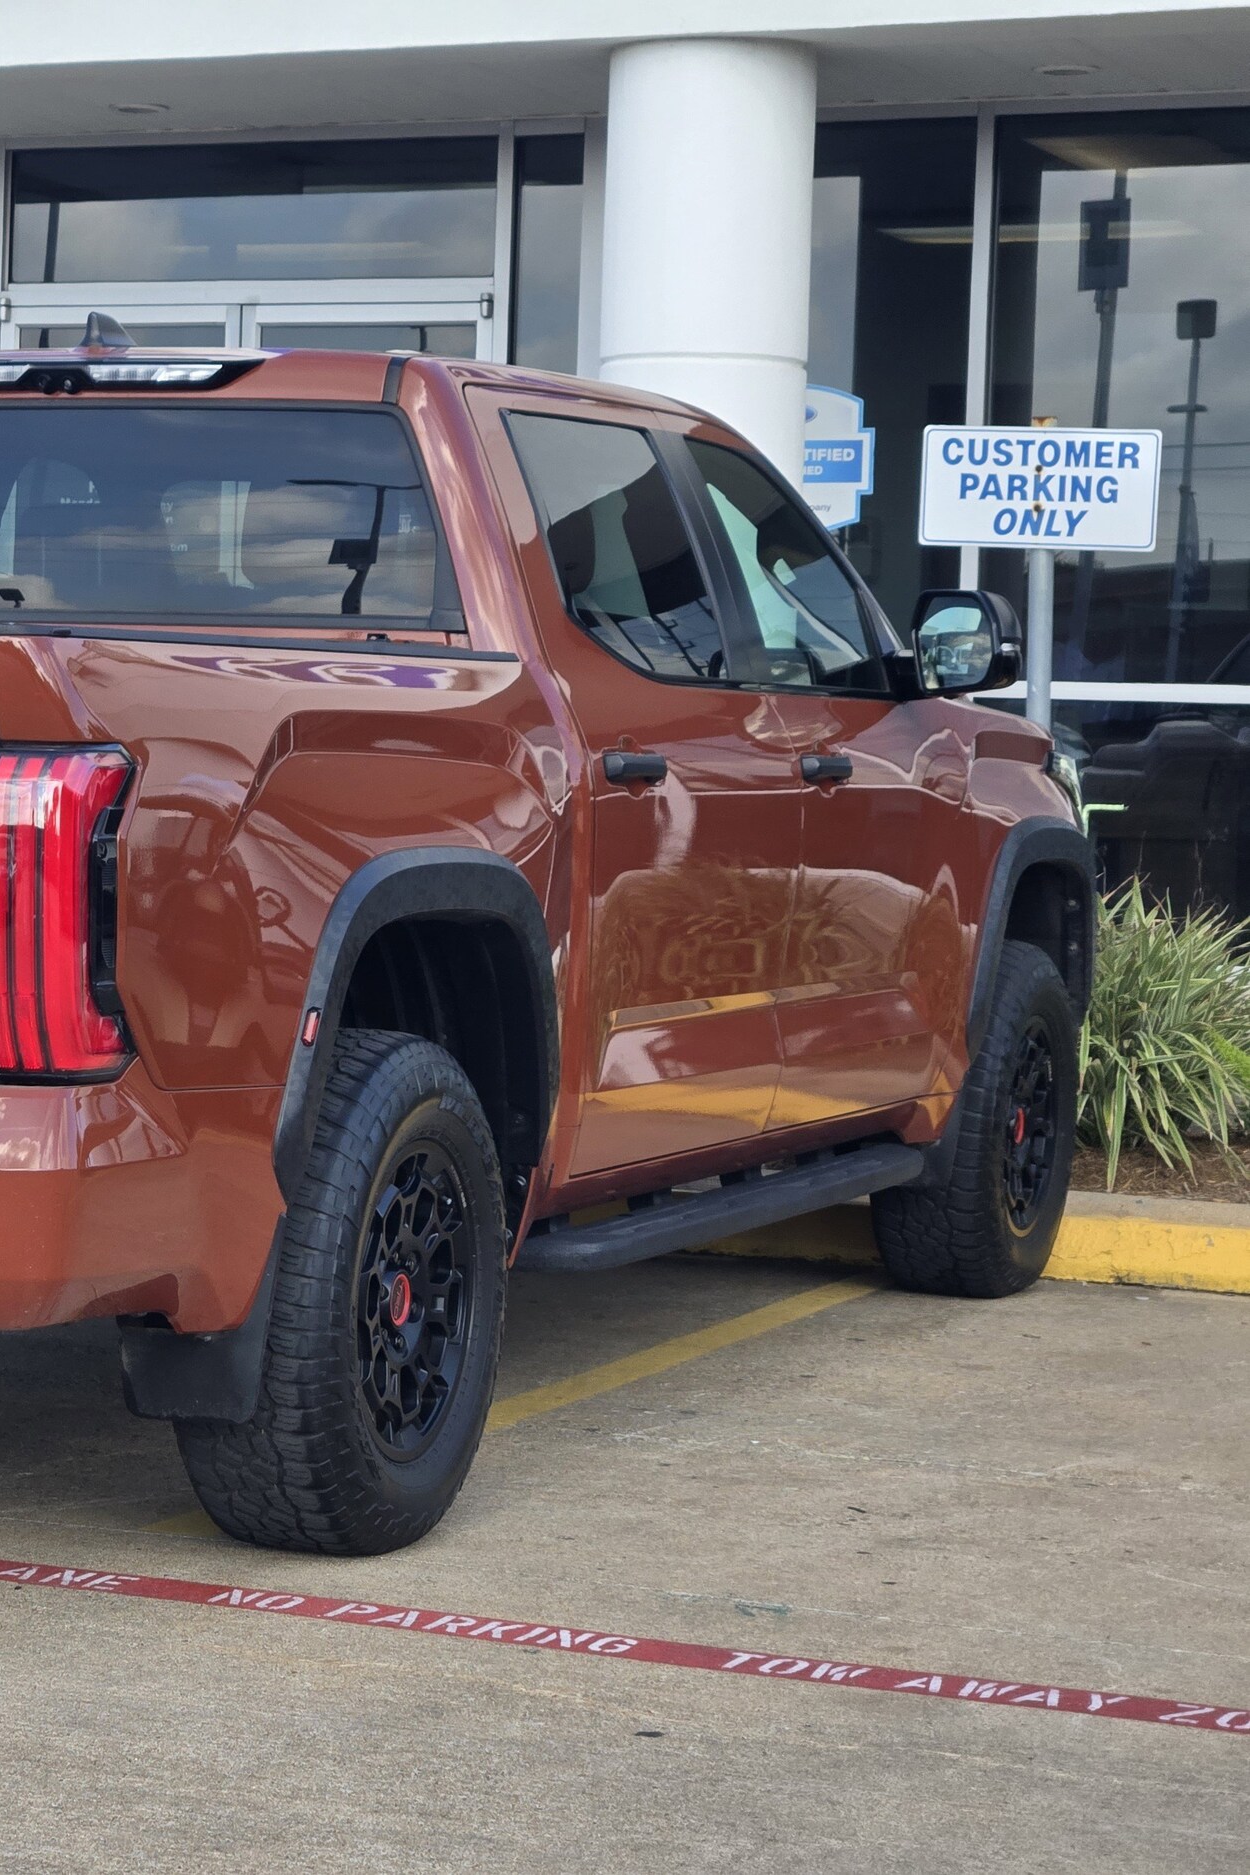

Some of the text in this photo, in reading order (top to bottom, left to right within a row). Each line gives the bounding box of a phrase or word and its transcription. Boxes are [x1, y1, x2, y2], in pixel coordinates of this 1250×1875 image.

[805, 447, 855, 461] TIFIED
[942, 437, 1140, 469] CUSTOMER
[959, 473, 1119, 504] PARKING
[993, 508, 1088, 537] ONLY
[206, 1588, 638, 1654] NO PARKING
[721, 1651, 1250, 1729] TOW AWAY ZO
